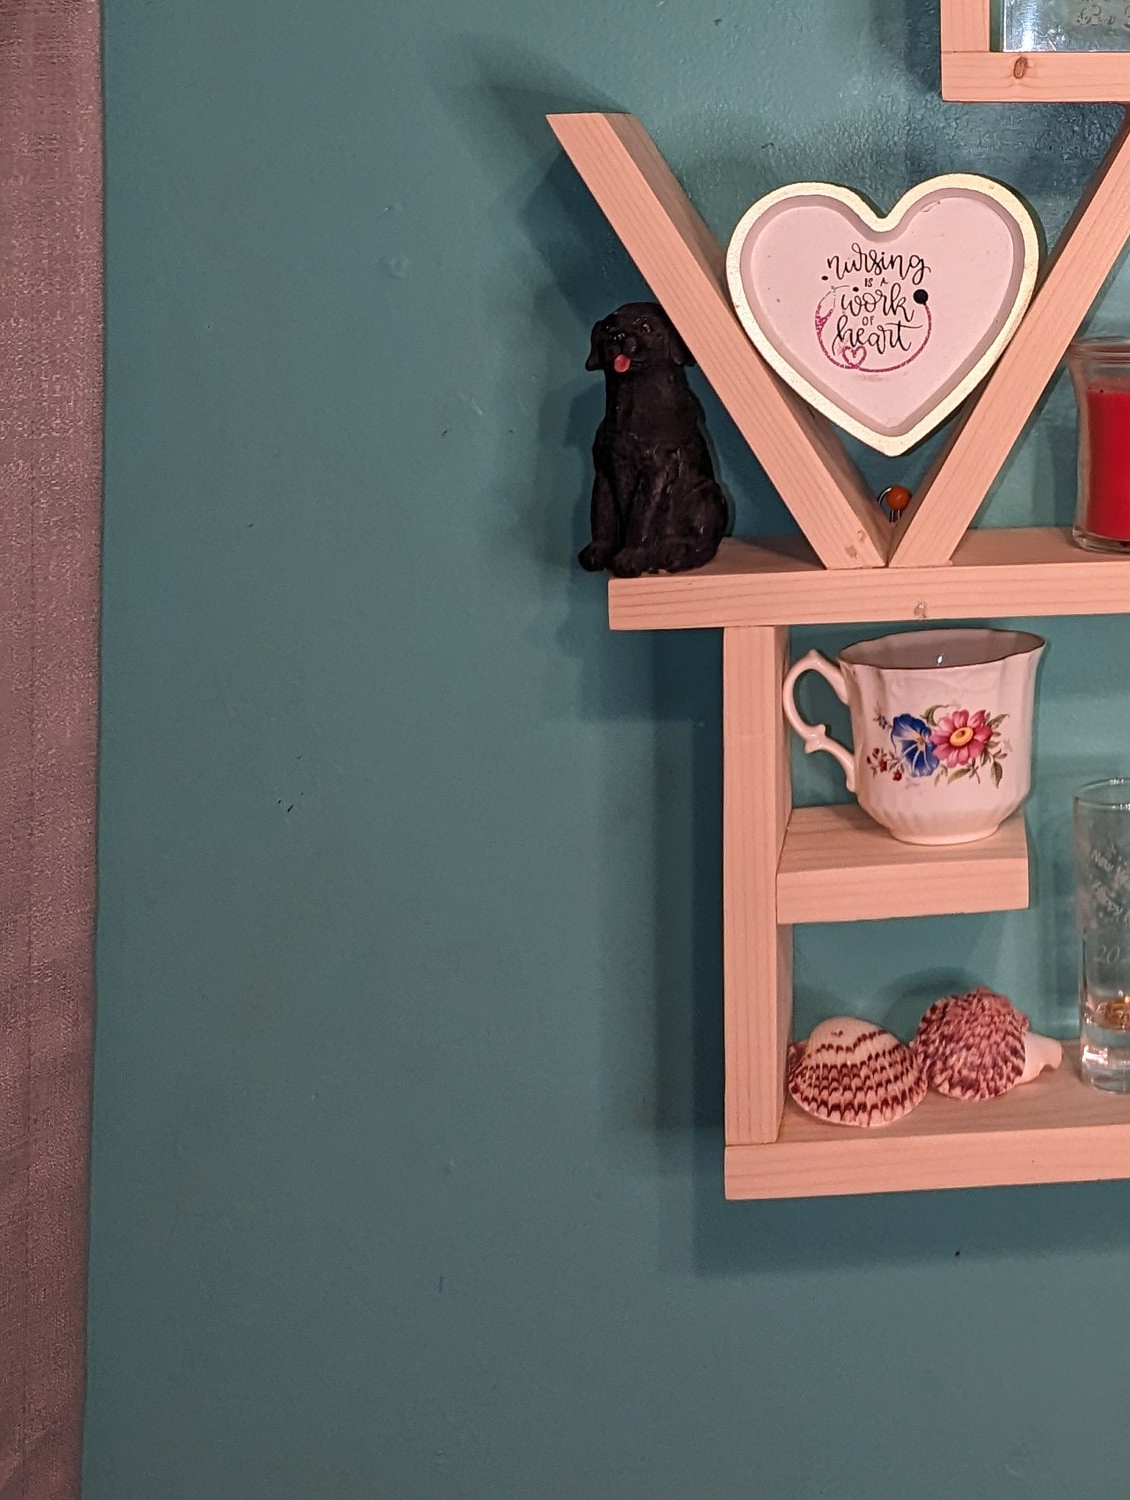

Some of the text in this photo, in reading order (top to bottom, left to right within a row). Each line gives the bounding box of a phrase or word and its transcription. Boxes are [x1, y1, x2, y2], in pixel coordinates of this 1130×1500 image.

[827, 242, 931, 286] nursing
[864, 278, 873, 287] IS
[841, 282, 915, 322] work
[862, 315, 875, 327] OF
[831, 314, 923, 356] heart
